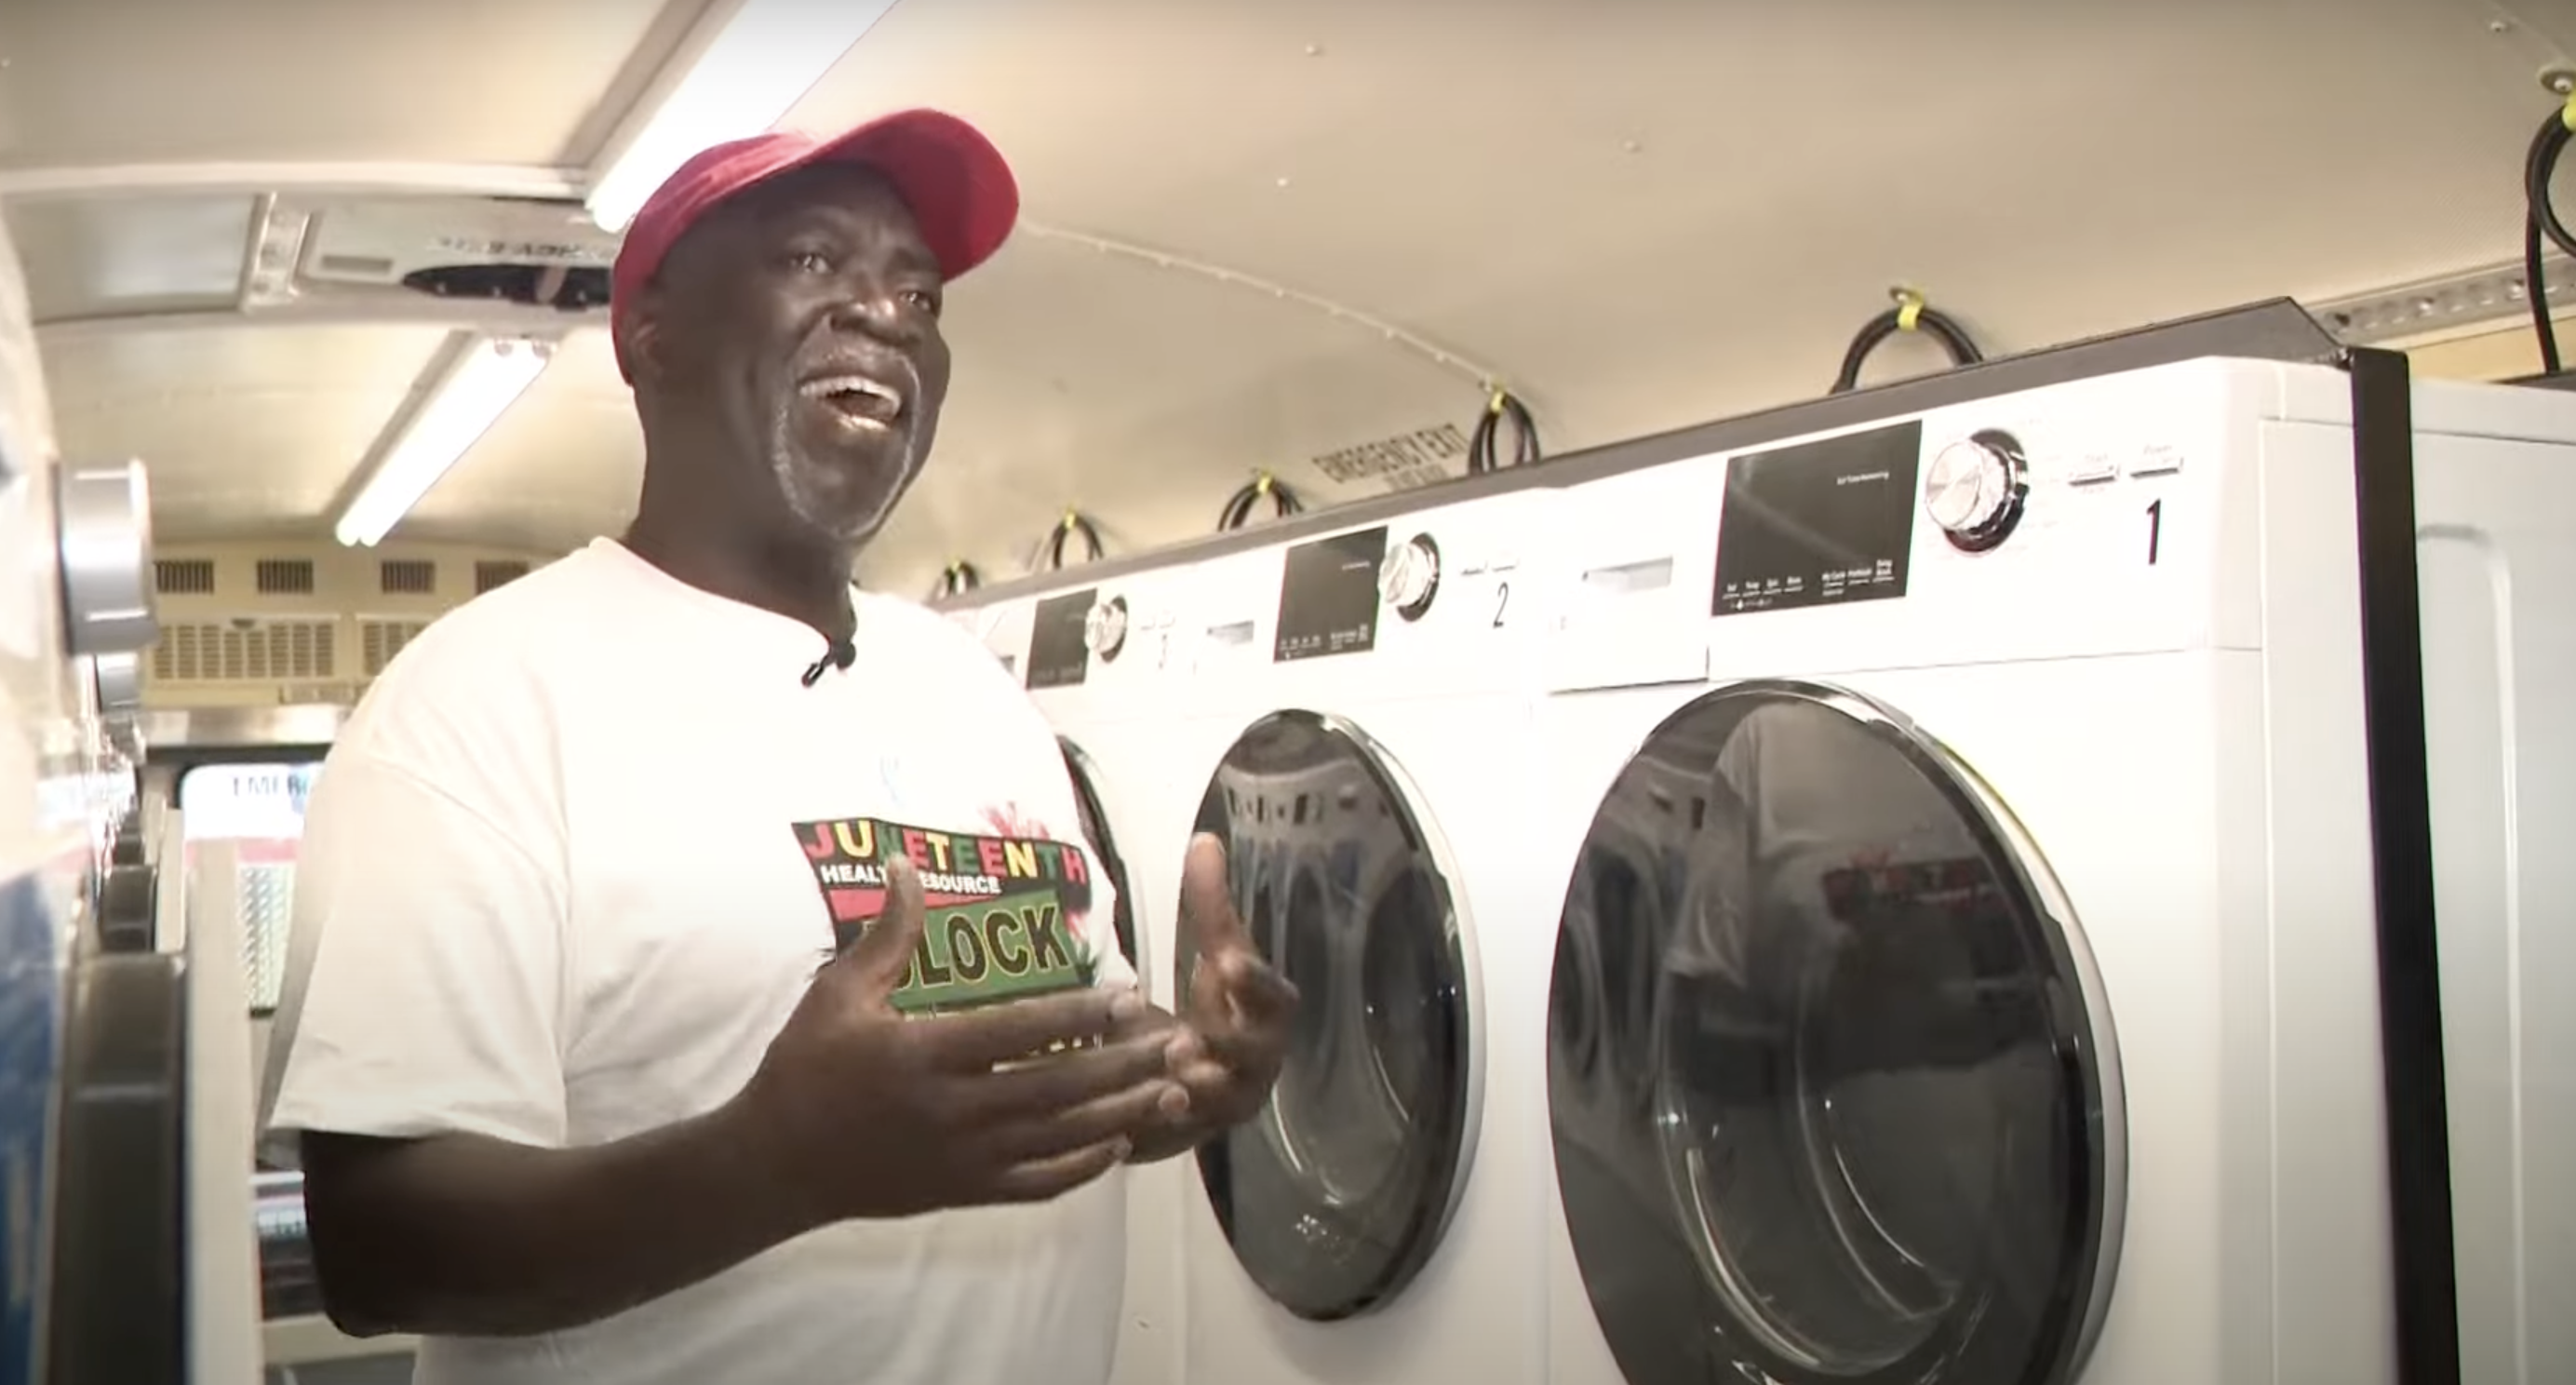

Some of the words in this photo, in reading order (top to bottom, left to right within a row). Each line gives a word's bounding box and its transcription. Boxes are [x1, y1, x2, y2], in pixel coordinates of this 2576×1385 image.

[2146, 498, 2162, 566] 1
[1493, 582, 1509, 628] 2
[805, 819, 1087, 884] JUNETEENTH
[820, 864, 888, 884] HEALT
[918, 869, 1002, 894] ESOURCE
